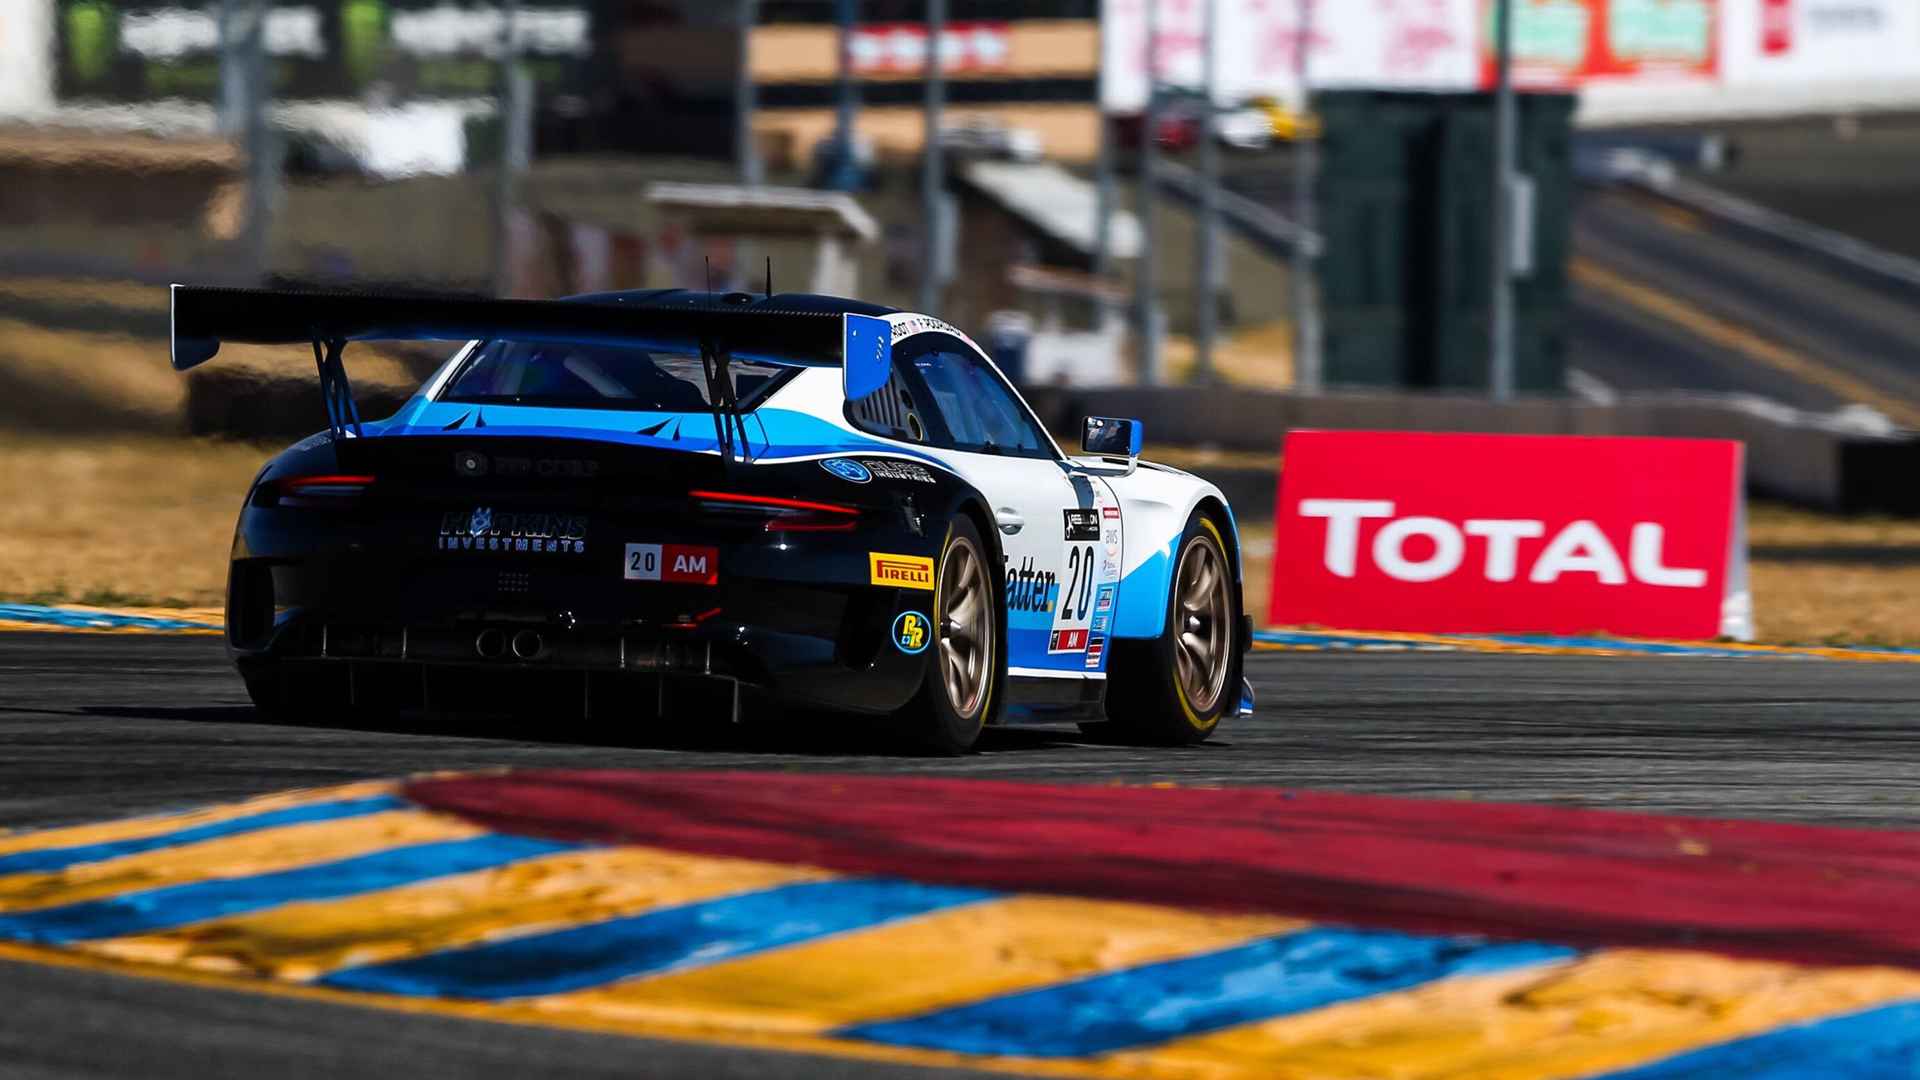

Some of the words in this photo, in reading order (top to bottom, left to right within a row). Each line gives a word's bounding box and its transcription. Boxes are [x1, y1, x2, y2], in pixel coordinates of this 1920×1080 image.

[535, 459, 600, 478] CORP
[439, 536, 585, 553] INVESTMENTS
[1299, 498, 1708, 587] TOTAL
[630, 552, 656, 572] 20
[672, 555, 707, 574] AM
[876, 559, 930, 583] PIRELLI
[1003, 554, 1054, 613] atter.
[1060, 545, 1095, 621] 20
[1066, 631, 1080, 648] AM
